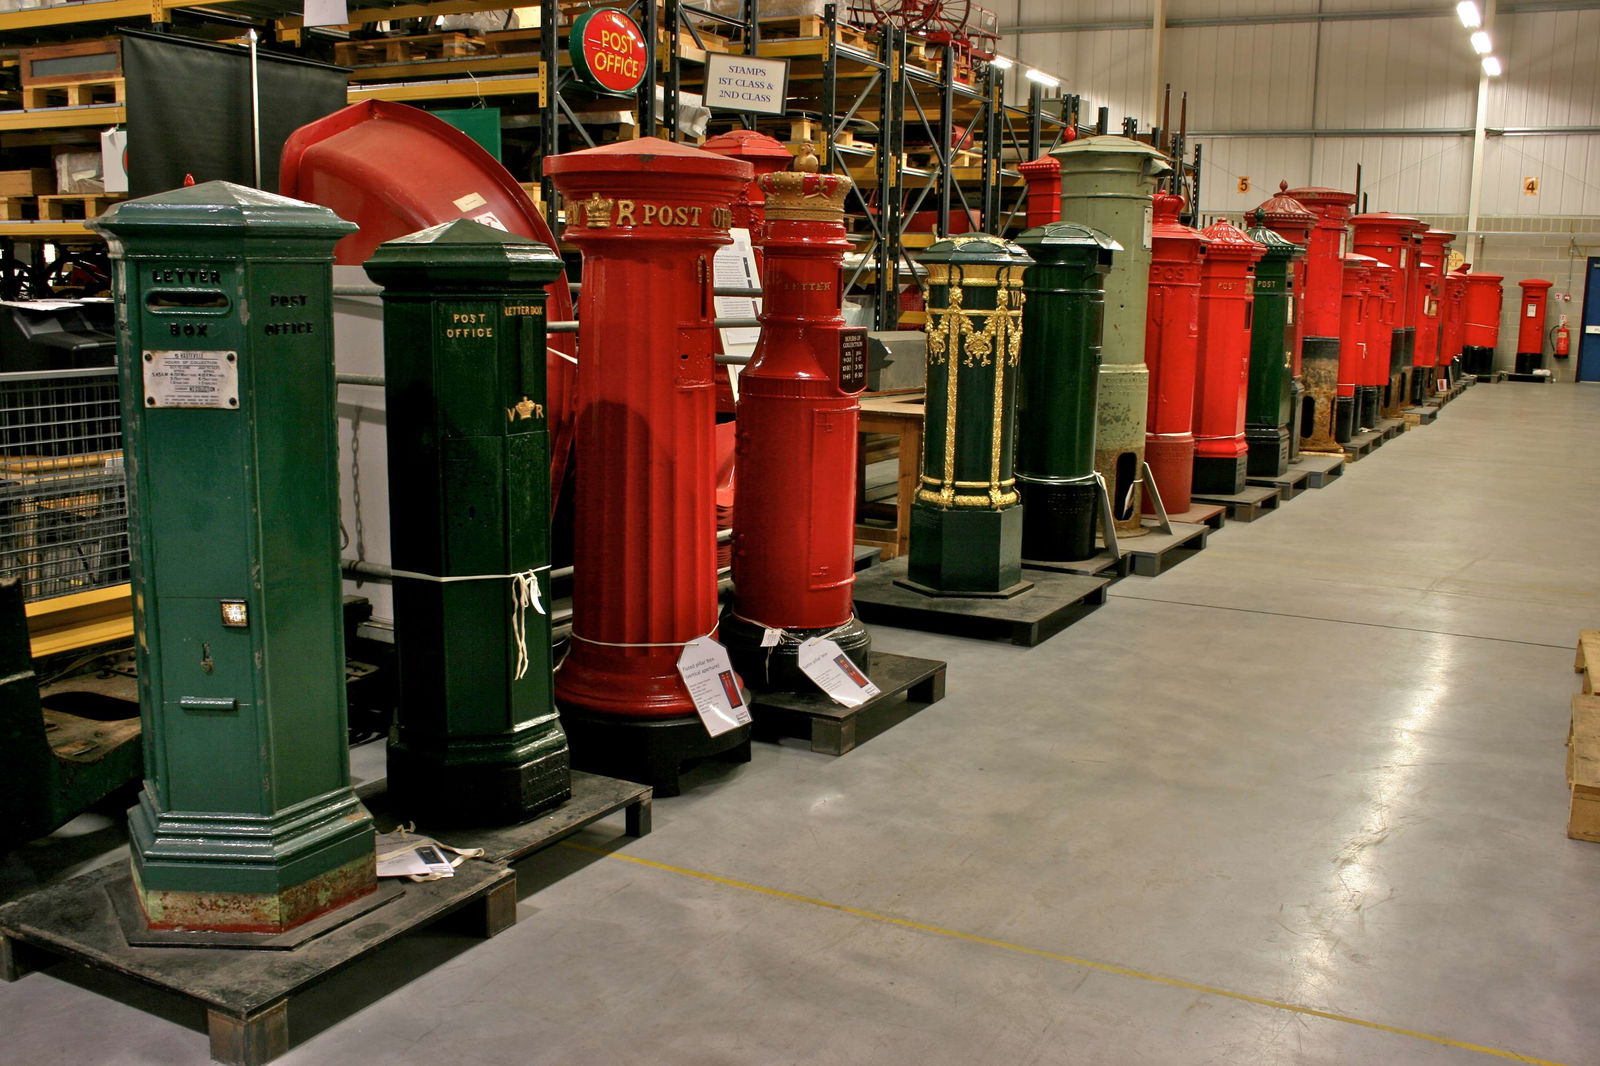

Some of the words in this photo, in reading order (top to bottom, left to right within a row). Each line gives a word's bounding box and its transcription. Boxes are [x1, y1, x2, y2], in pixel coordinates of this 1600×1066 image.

[601, 30, 635, 54] POST
[594, 52, 638, 78] OFFICE
[728, 65, 766, 76] STAMPS
[735, 79, 765, 90] CLASS
[719, 90, 739, 99] 2ND
[741, 93, 771, 102] CLASS
[1240, 178, 1248, 191] 5
[1526, 180, 1536, 193] 4
[616, 200, 638, 226] R
[642, 204, 703, 227] POST
[152, 268, 221, 285] LETTER
[1217, 282, 1238, 290] POST
[1257, 280, 1276, 289] POST
[270, 295, 308, 307] POST
[504, 306, 530, 316] LETTER
[530, 306, 543, 315] BOX
[453, 313, 486, 323] POST
[169, 323, 208, 337] BOX
[264, 322, 314, 336] OFFICE
[446, 328, 493, 338] OFFICE
[507, 408, 515, 422] V
[535, 404, 544, 419] R
